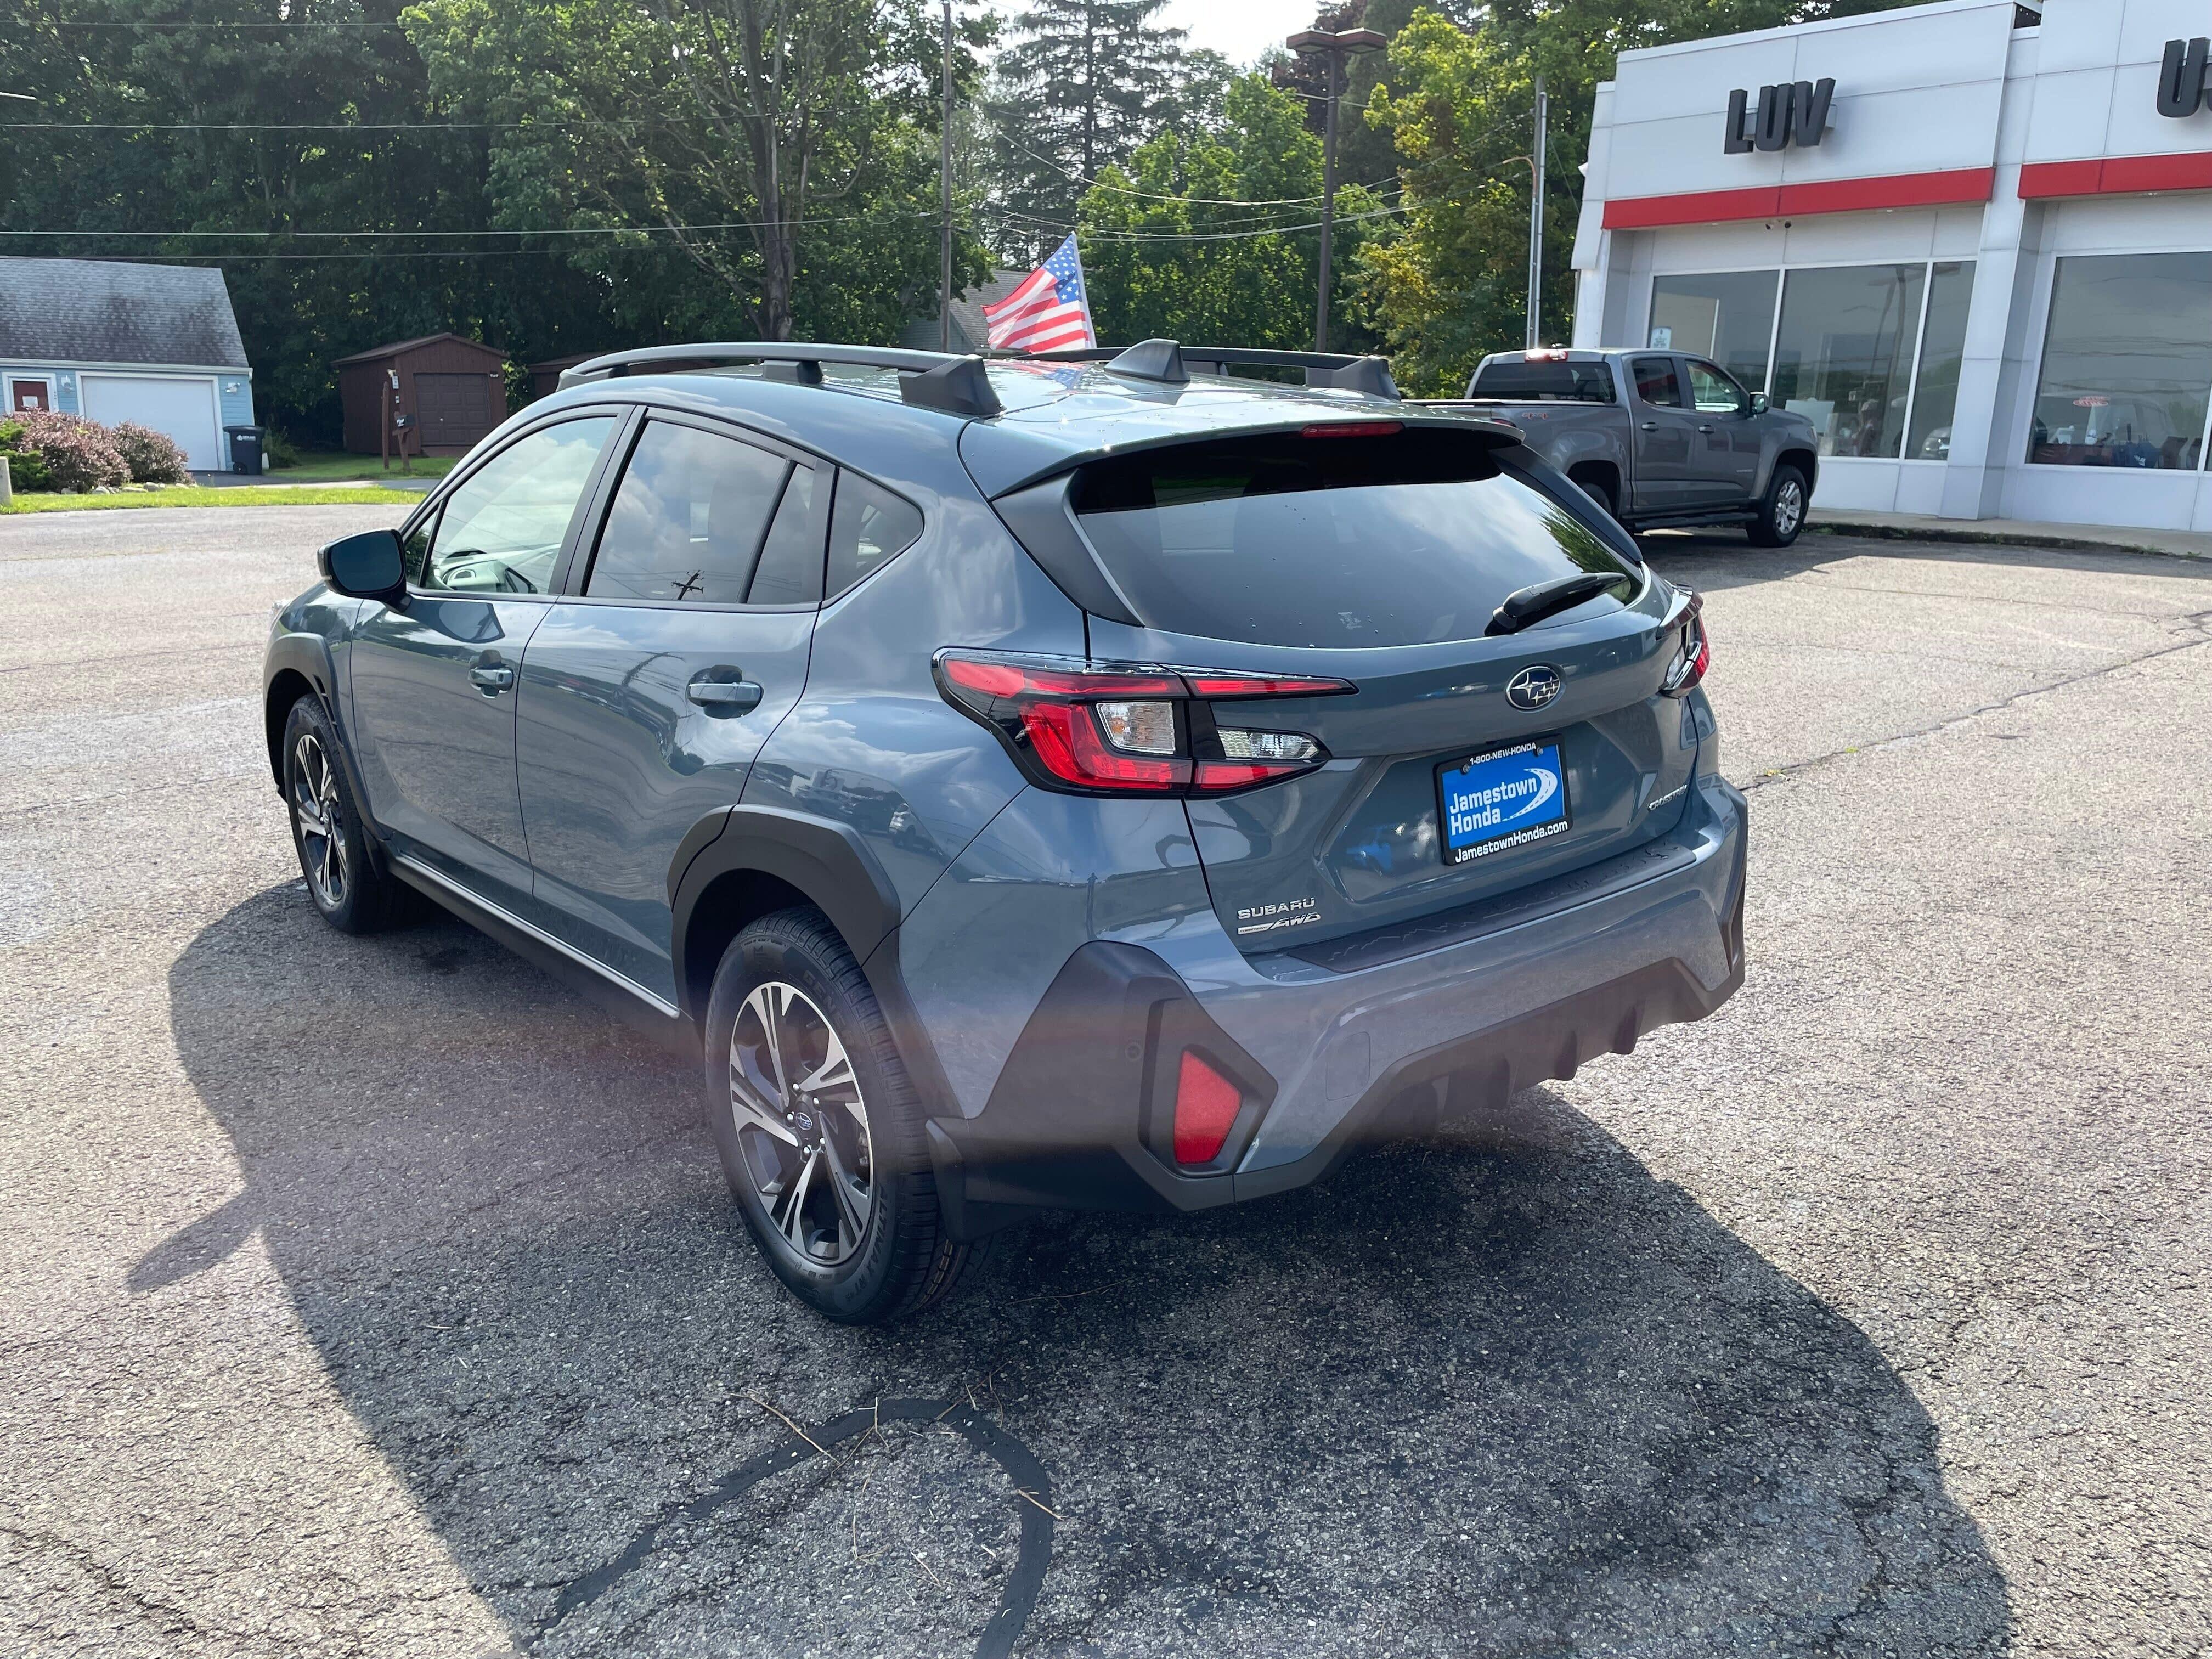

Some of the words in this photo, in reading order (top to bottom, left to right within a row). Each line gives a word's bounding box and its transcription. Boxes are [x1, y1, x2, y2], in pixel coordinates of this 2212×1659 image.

[1724, 77, 1836, 154] LUV
[2157, 37, 2212, 117] U
[1470, 742, 1537, 765] 1-800-NEW-HONDA
[1449, 777, 1537, 814] Jamestown
[1450, 805, 1502, 836] Honda
[1455, 821, 1568, 864] JamestownHonda.com
[1238, 897, 1316, 919] SUBARU
[1269, 912, 1321, 929] AWD
